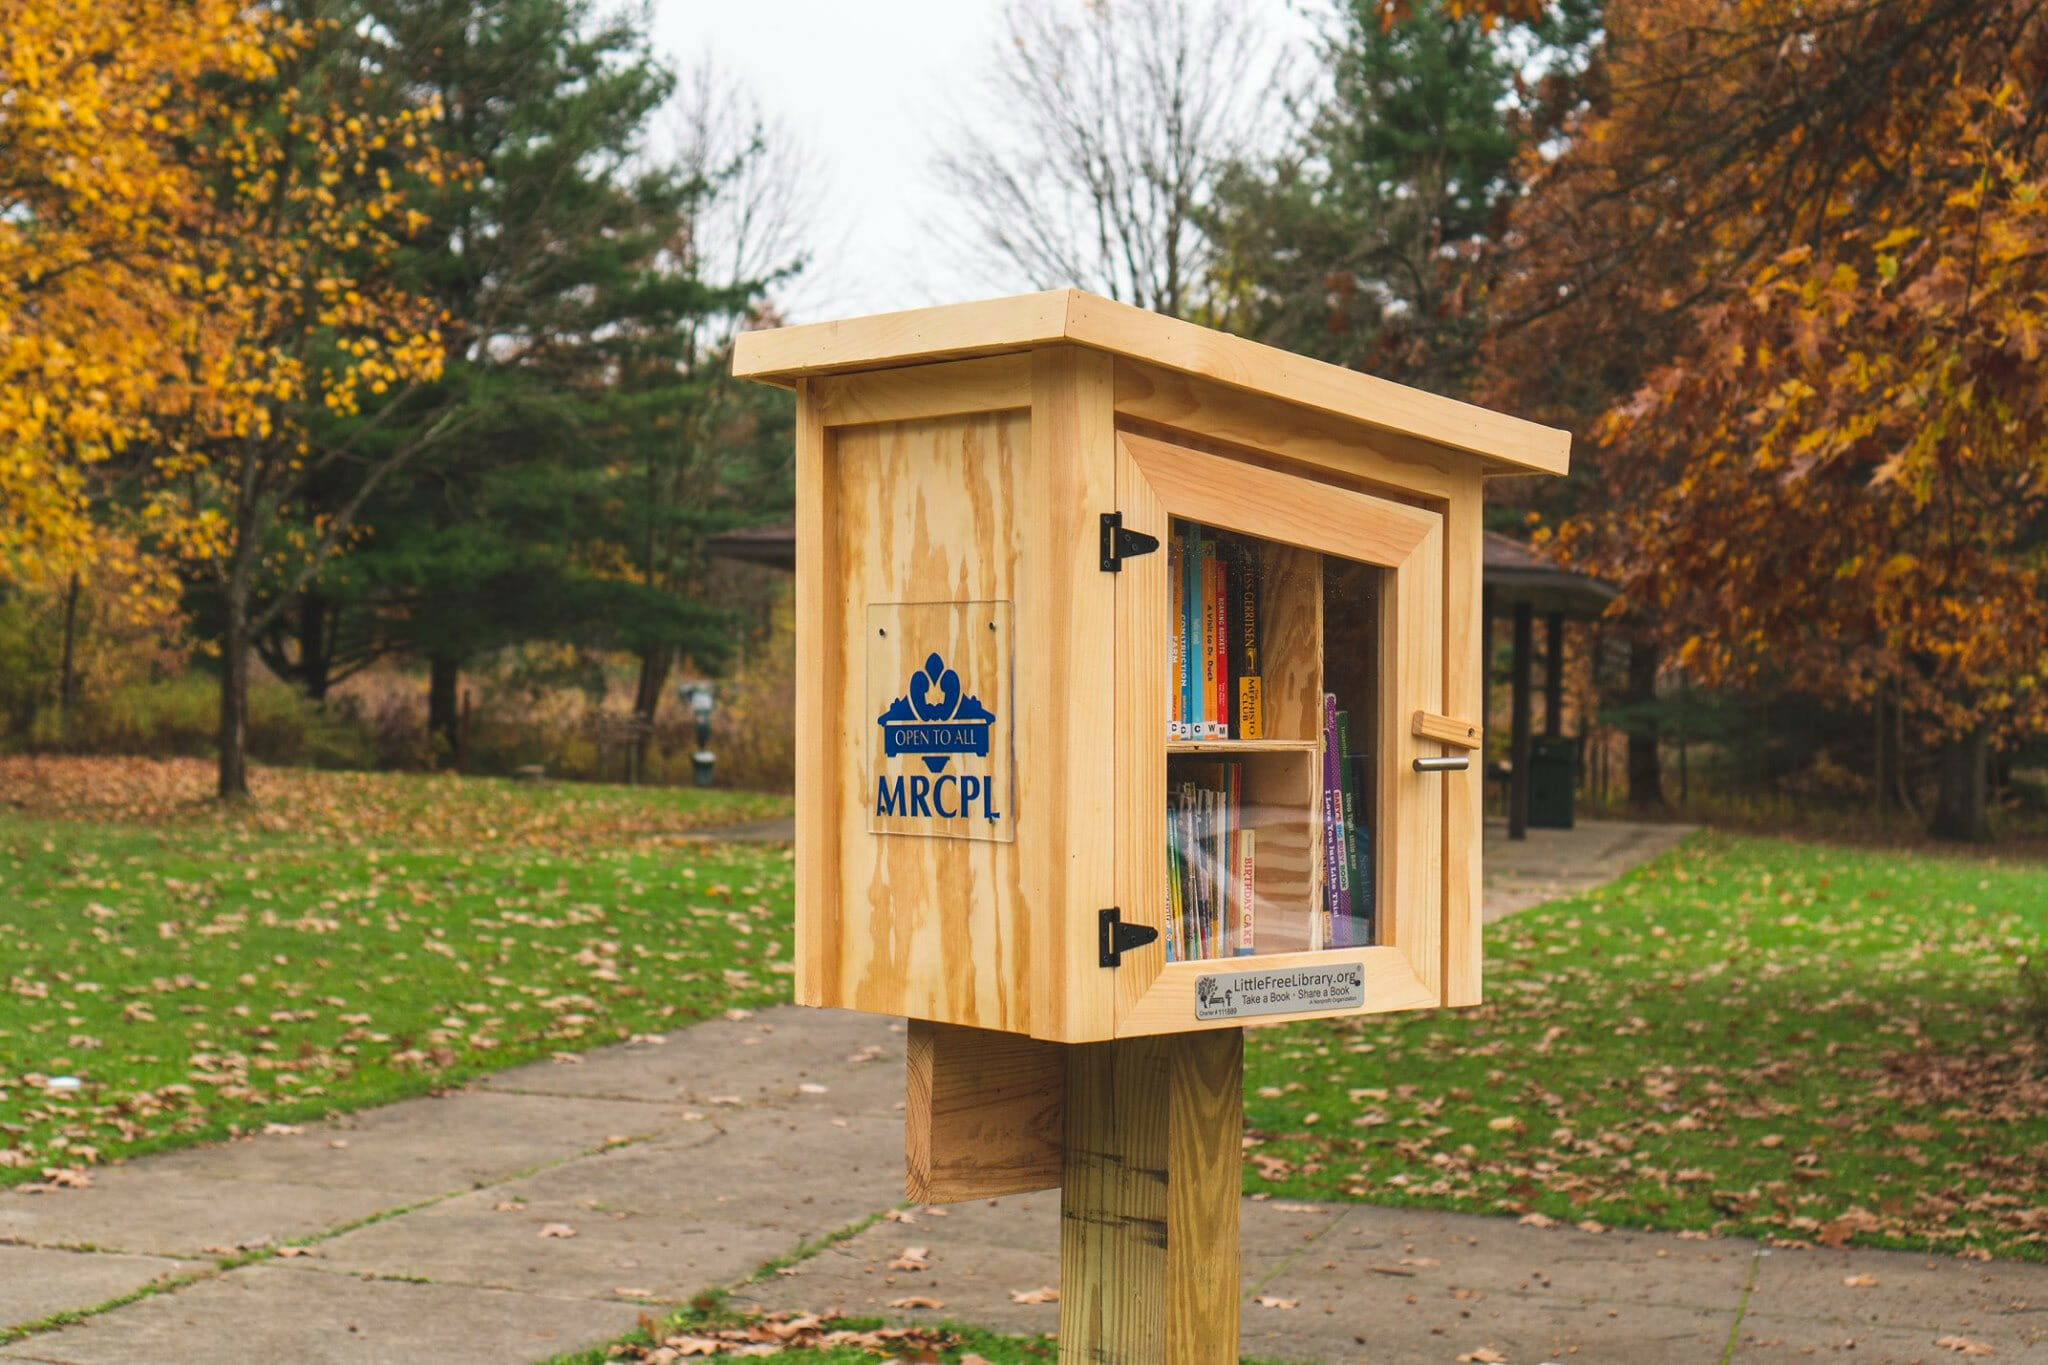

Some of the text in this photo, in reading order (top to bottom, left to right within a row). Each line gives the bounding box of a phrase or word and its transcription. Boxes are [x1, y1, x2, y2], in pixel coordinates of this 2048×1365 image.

[1244, 592, 1256, 648] GERRITSEN
[1207, 635, 1212, 644] to
[1248, 679, 1256, 735] MEPHISTO
[895, 728, 977, 746] OPEN TO ALL
[1194, 725, 1201, 733] C
[1208, 724, 1216, 732] W
[876, 774, 1001, 819] MRCPL
[1334, 792, 1342, 823] BABY'S
[1243, 857, 1253, 910] BIRTHDAY
[1332, 892, 1340, 918] This!
[1243, 914, 1252, 945] CAKE
[1234, 971, 1357, 992] LittleFreeLibrary.org
[1242, 994, 1261, 1005] Take
[1270, 992, 1291, 1003] Book
[1298, 988, 1321, 1000] Share
[1330, 985, 1350, 996] Book
